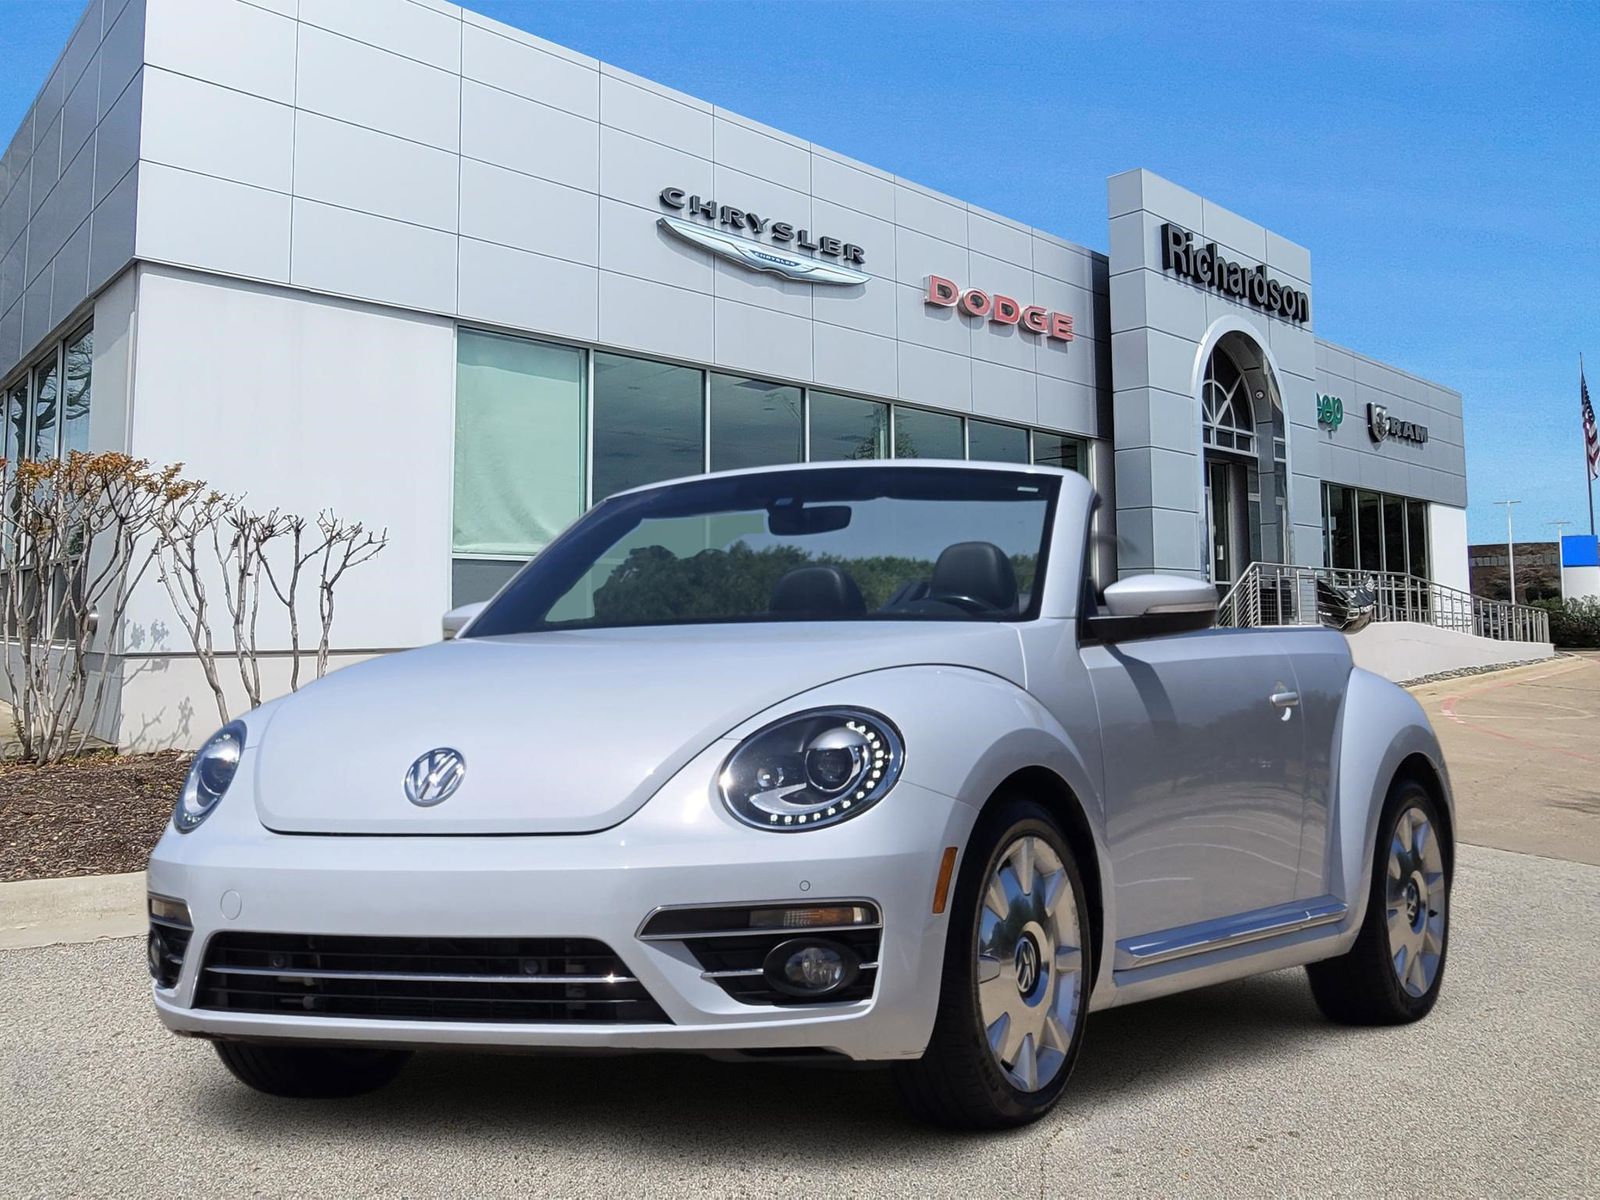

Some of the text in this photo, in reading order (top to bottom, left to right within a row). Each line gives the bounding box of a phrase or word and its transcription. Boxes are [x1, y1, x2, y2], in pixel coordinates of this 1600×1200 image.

[659, 187, 866, 264] CHRYSLER
[923, 275, 1073, 342] DODGE
[1161, 223, 1309, 323] Richardson
[1388, 416, 1428, 443] RAM
